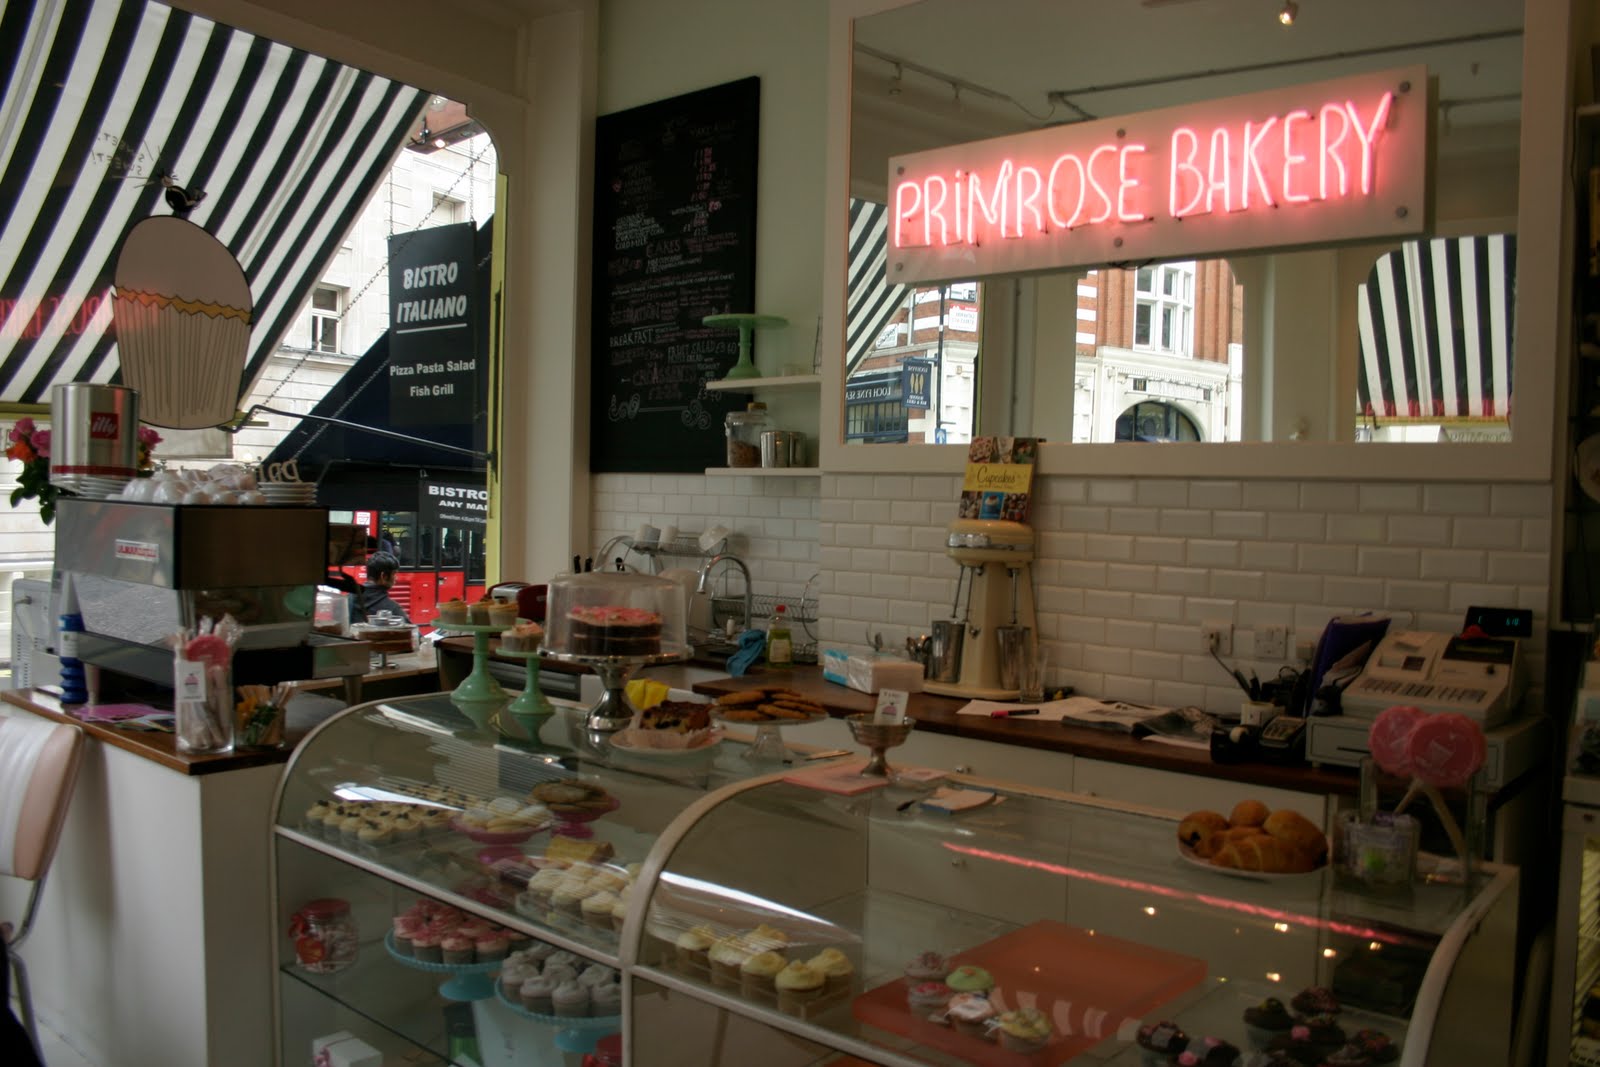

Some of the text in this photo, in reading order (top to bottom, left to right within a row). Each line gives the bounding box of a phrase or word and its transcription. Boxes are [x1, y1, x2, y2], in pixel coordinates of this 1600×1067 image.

[1168, 91, 1394, 219] BAKERY
[403, 262, 458, 289] BISTRO
[396, 295, 467, 323] ITALIANO
[609, 328, 654, 348] BREAKFAST
[390, 359, 476, 376] Pizza Pasta Salad
[410, 384, 454, 397] Fish Grill
[92, 416, 117, 437] illy
[428, 485, 488, 500] BISTRO
[438, 500, 463, 508] ANY
